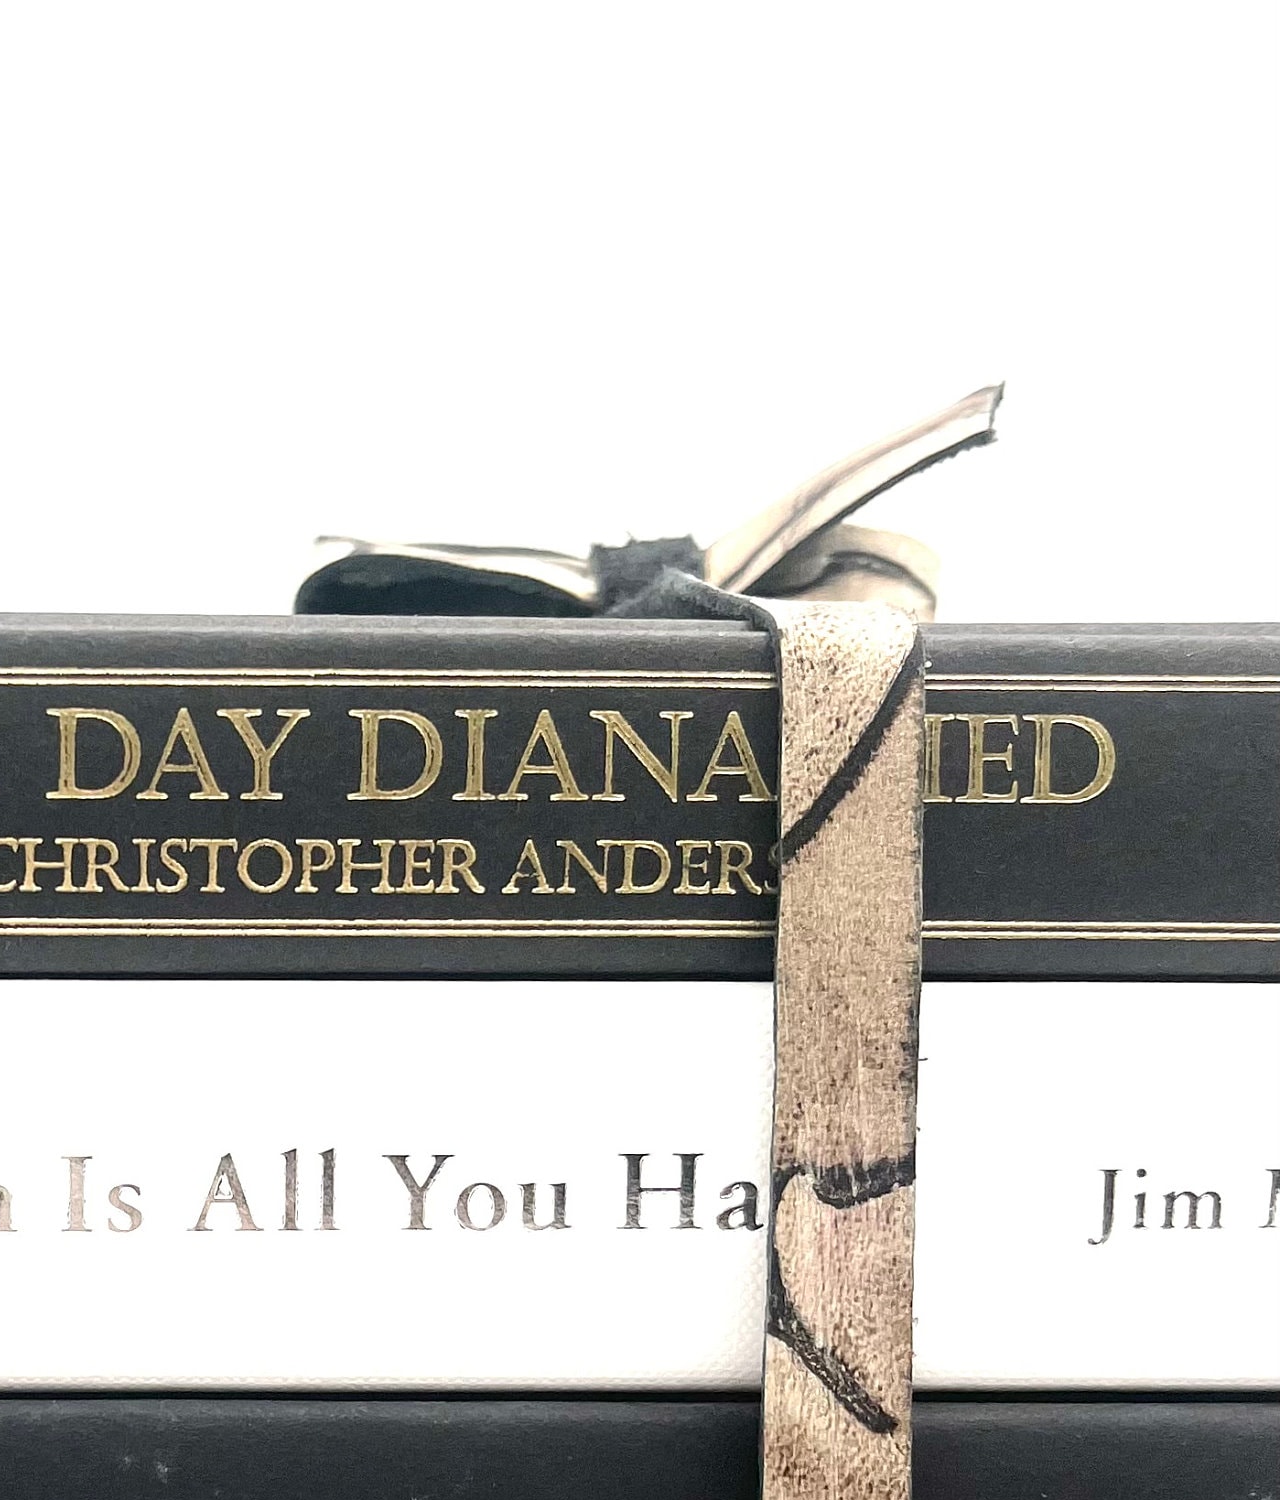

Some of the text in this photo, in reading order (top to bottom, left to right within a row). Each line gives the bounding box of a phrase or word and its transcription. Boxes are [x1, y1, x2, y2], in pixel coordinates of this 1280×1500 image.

[45, 707, 312, 801] DAY
[346, 708, 778, 802] DIANA
[922, 713, 1117, 804] IED
[501, 839, 781, 896] ANDER
[60, 1155, 143, 1233] Is
[186, 1147, 341, 1233] All
[381, 1153, 573, 1232] You
[616, 1153, 765, 1232] Ha
[1087, 1167, 1224, 1246] Jim
